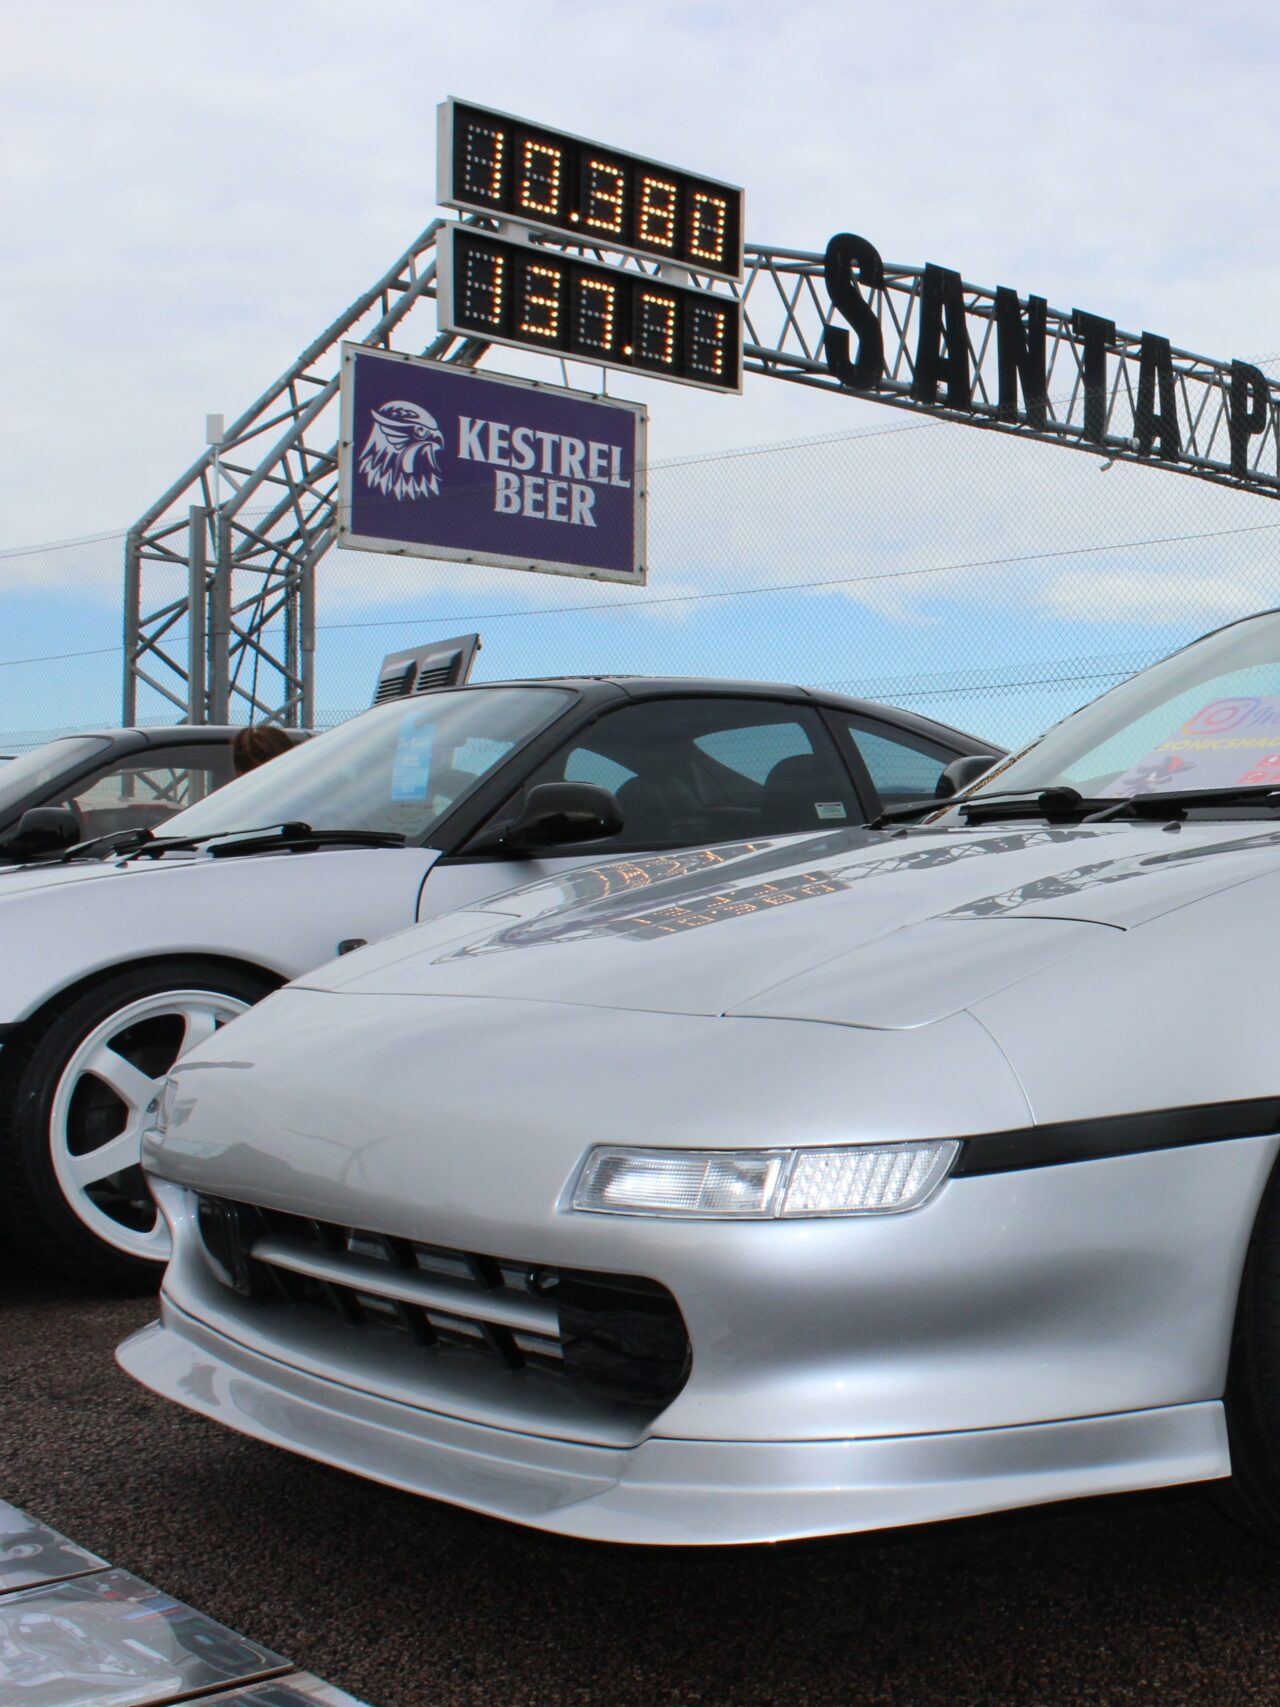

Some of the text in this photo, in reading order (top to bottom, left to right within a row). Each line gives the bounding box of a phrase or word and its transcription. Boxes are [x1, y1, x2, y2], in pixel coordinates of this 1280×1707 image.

[494, 132, 727, 262] 10.380
[823, 232, 1182, 464] SANTA
[457, 415, 632, 489] KESTREL
[493, 469, 598, 528] BEER
